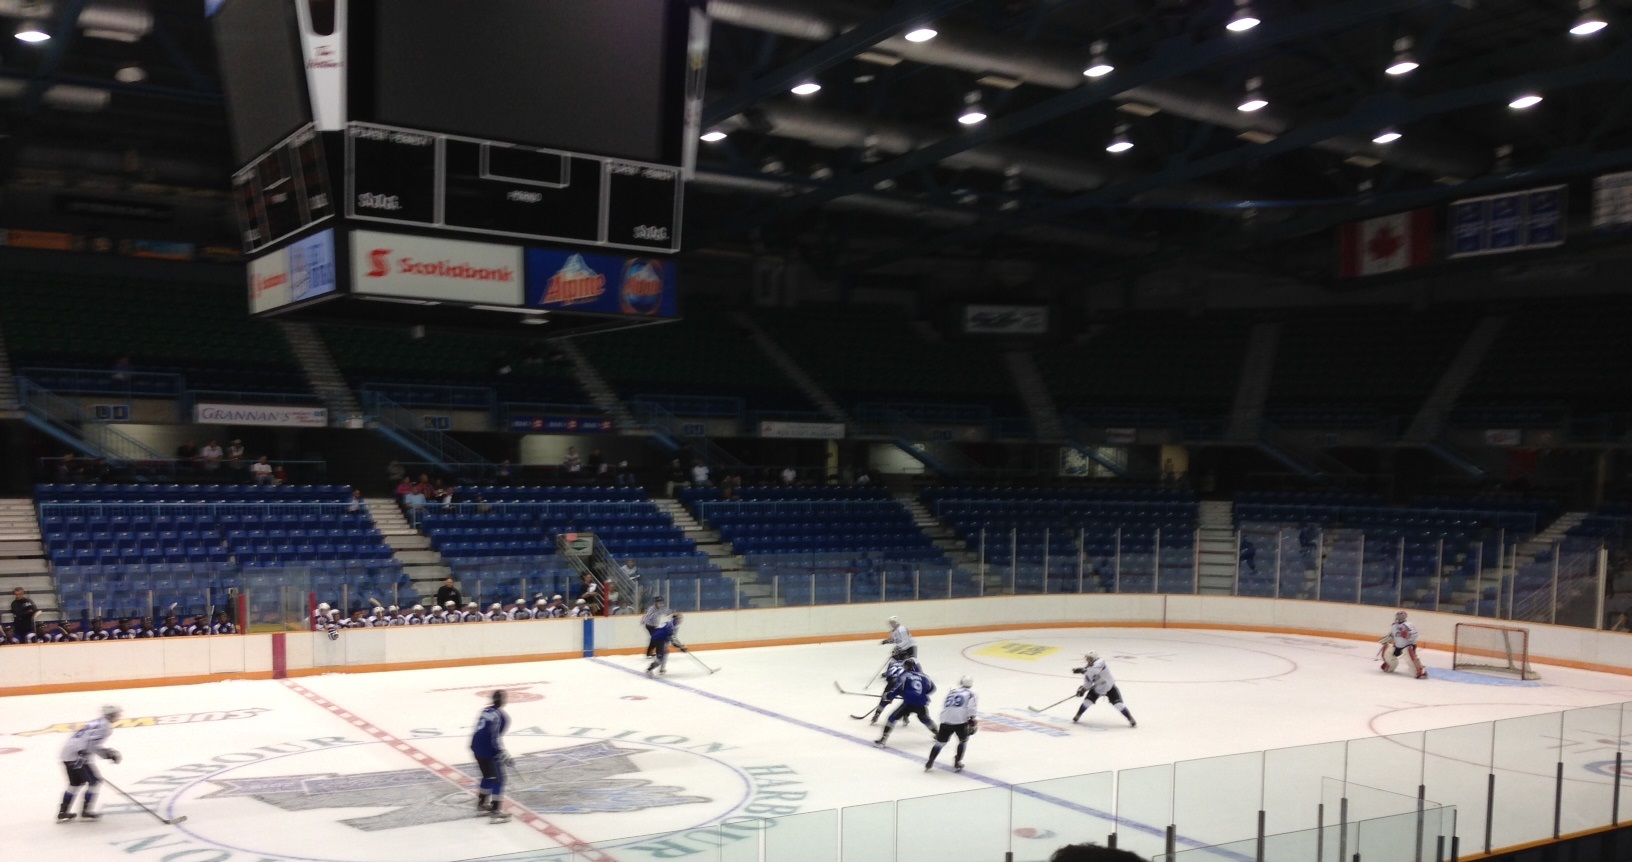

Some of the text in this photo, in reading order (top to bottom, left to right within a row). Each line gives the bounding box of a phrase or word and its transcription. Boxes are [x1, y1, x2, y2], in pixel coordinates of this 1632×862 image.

[400, 257, 515, 284] Scotiabank
[911, 680, 923, 695] 9
[409, 725, 742, 753] SATION
